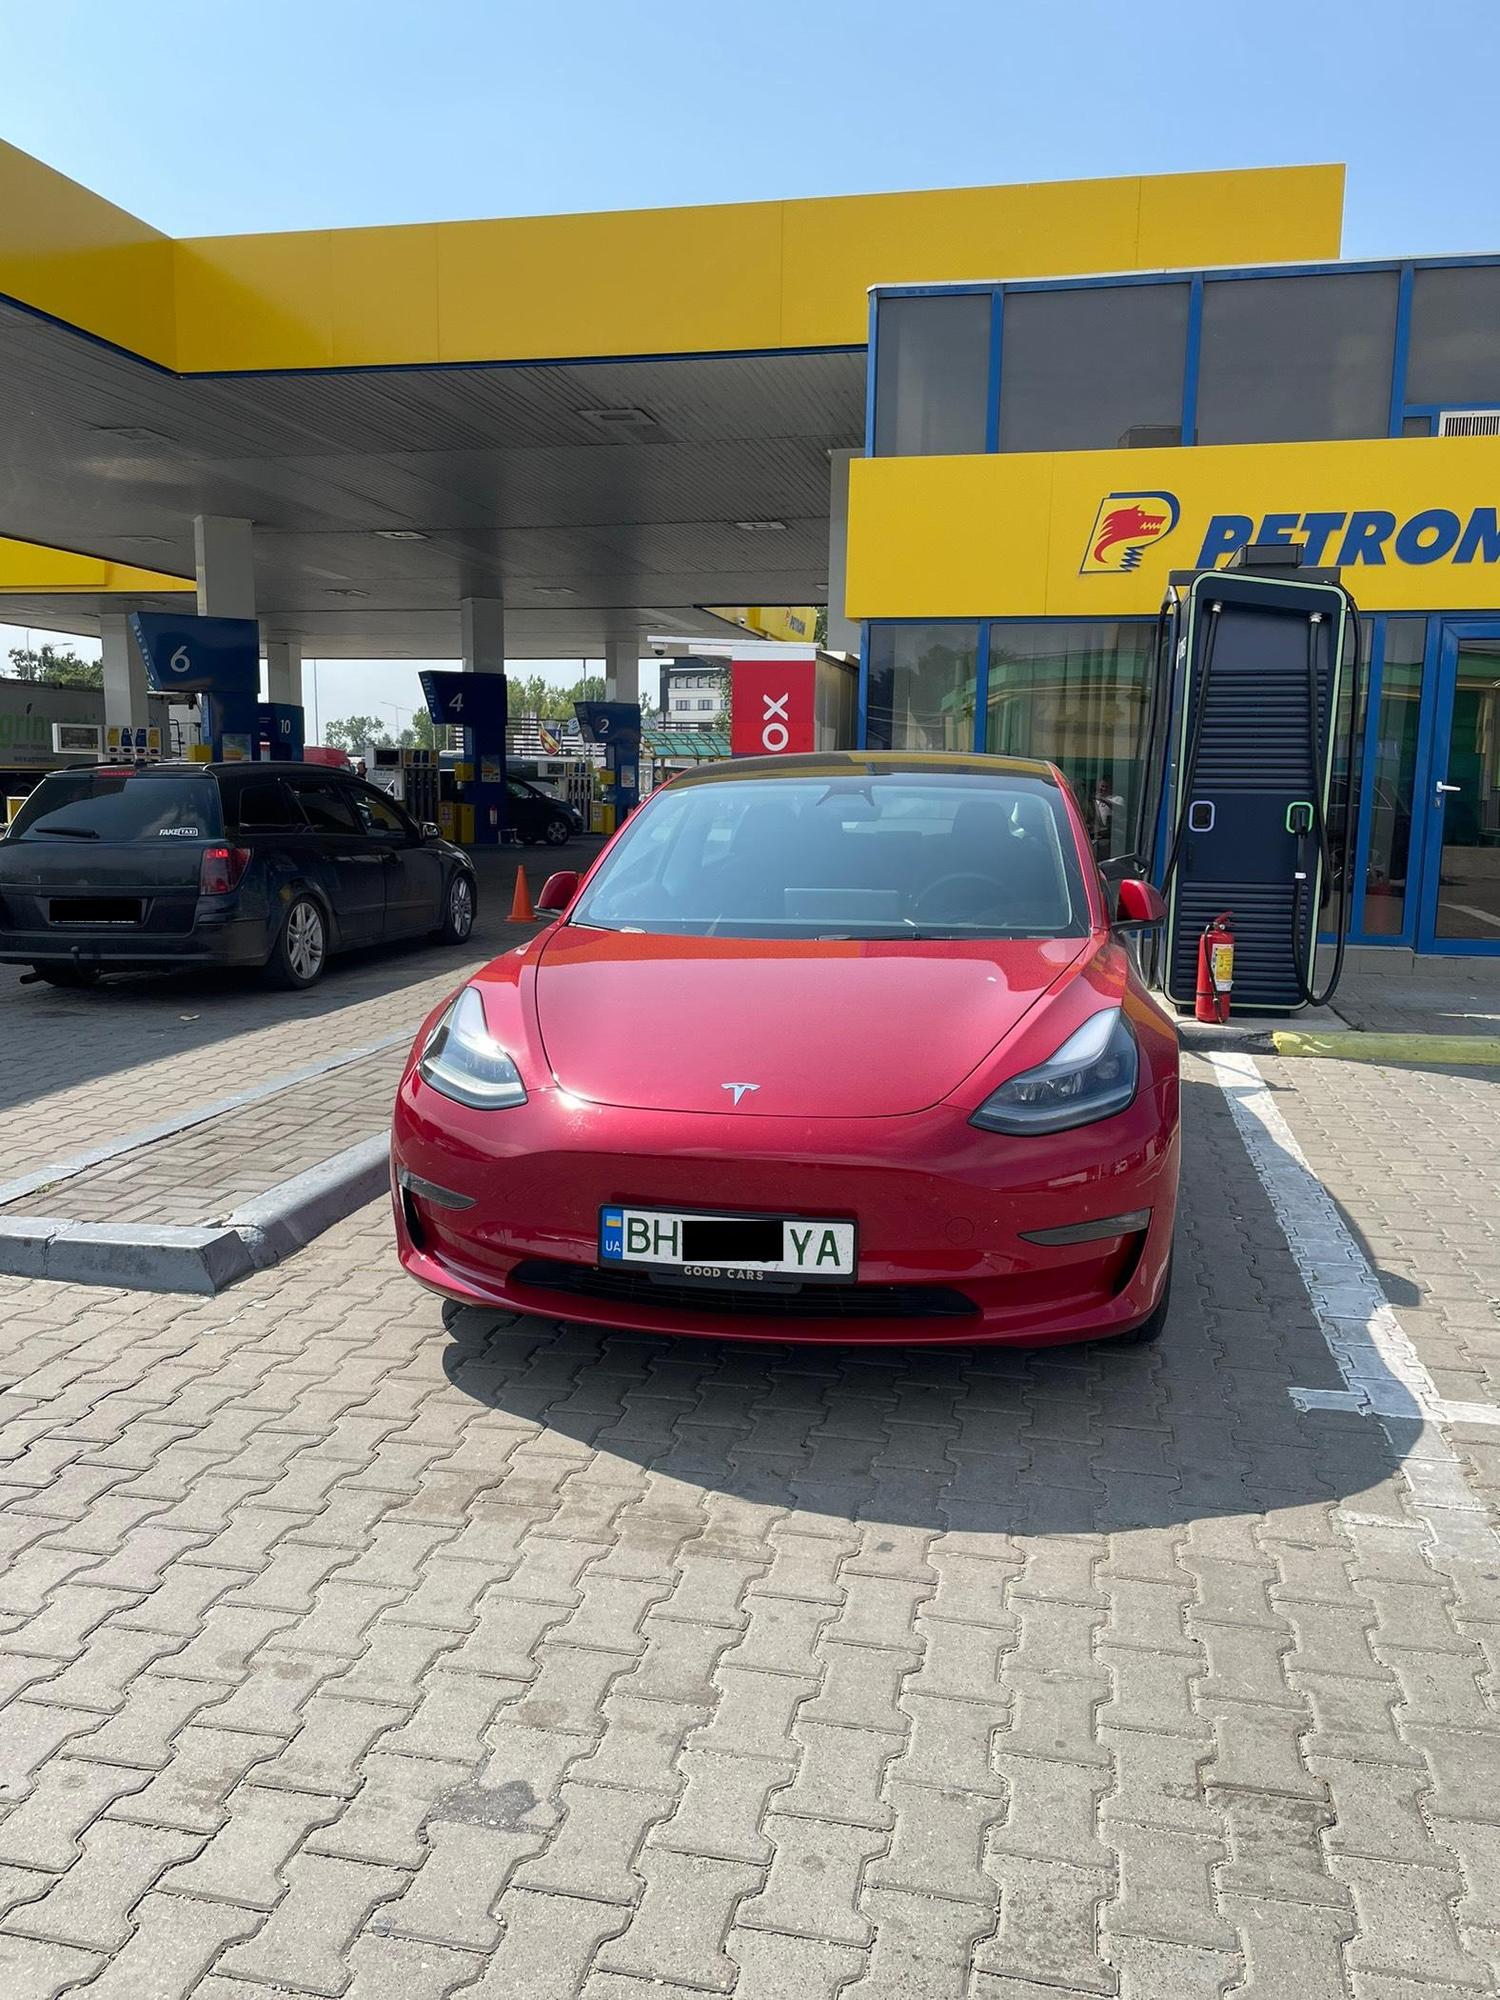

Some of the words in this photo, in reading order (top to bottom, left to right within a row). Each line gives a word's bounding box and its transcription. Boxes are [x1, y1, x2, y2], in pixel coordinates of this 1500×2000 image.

[170, 645, 190, 673] 6
[449, 693, 464, 712] 4
[279, 719, 291, 734] 10
[599, 718, 609, 734] 2
[605, 1240, 622, 1252] UA
[684, 1265, 721, 1278] GOOD
[727, 1269, 764, 1281] CARS
